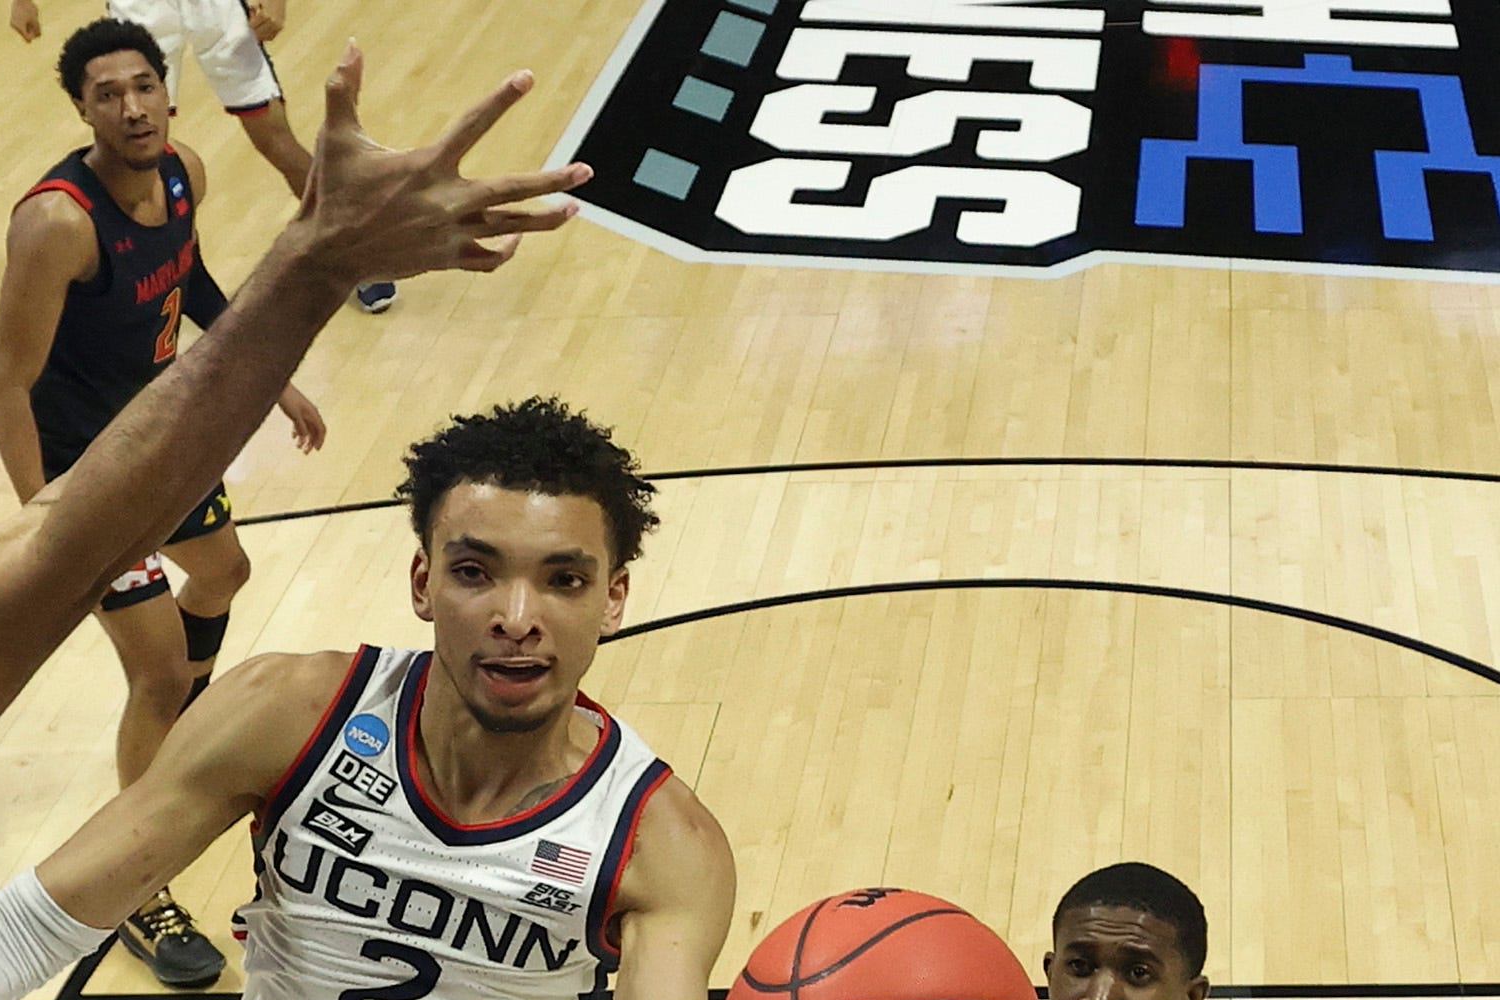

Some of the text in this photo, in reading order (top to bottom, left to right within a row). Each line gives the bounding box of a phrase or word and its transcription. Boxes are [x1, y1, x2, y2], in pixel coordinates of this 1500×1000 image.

[153, 286, 181, 364] 2
[347, 725, 384, 752] NCAA
[334, 754, 394, 802] DEE
[312, 810, 367, 844] BLM
[275, 832, 579, 970] UCONN
[524, 891, 582, 912] EAST
[533, 882, 575, 900] BIG
